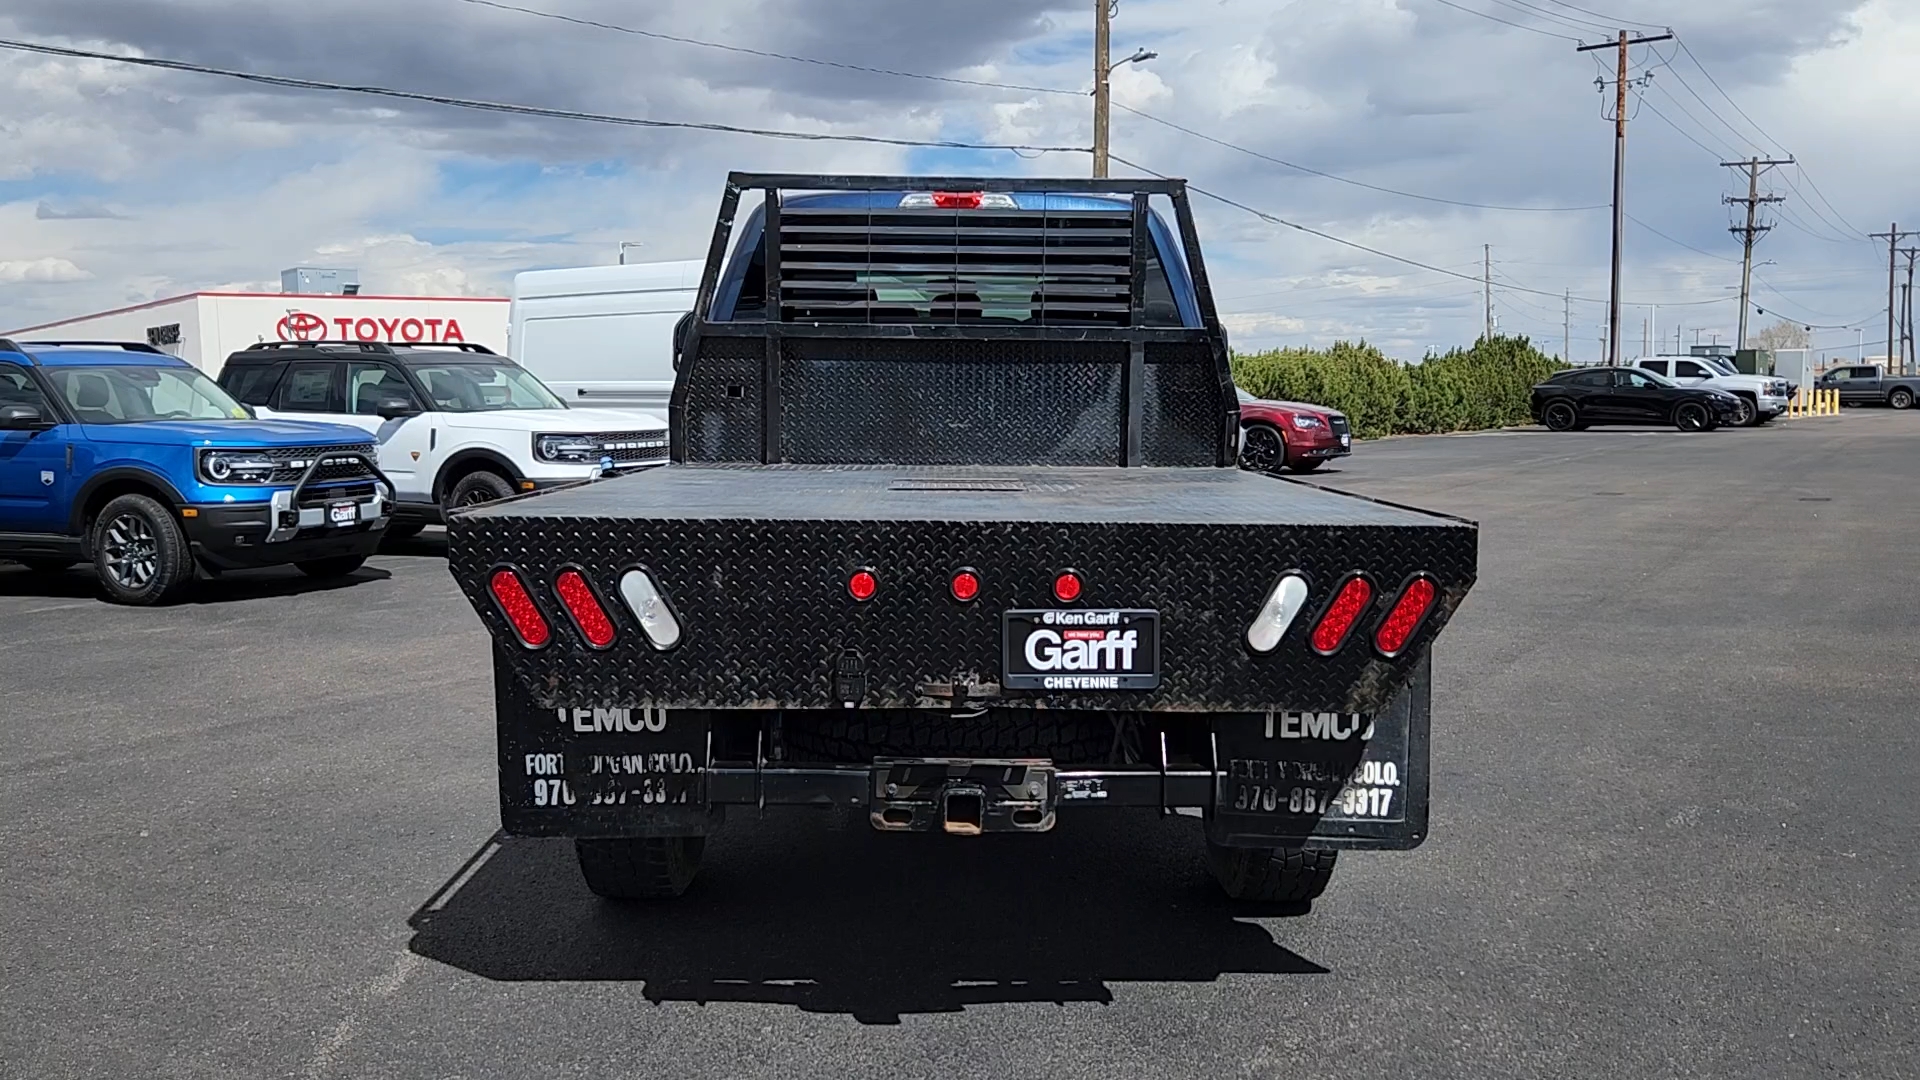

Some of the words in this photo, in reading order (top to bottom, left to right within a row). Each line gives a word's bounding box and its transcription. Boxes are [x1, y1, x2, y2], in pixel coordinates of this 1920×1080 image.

[334, 318, 464, 342] TOYOTA
[331, 506, 356, 522] Garff
[1056, 612, 1083, 625] Ken
[1085, 612, 1119, 625] Garff
[1025, 629, 1137, 670] Garff
[1044, 677, 1119, 689] CHEYENNE
